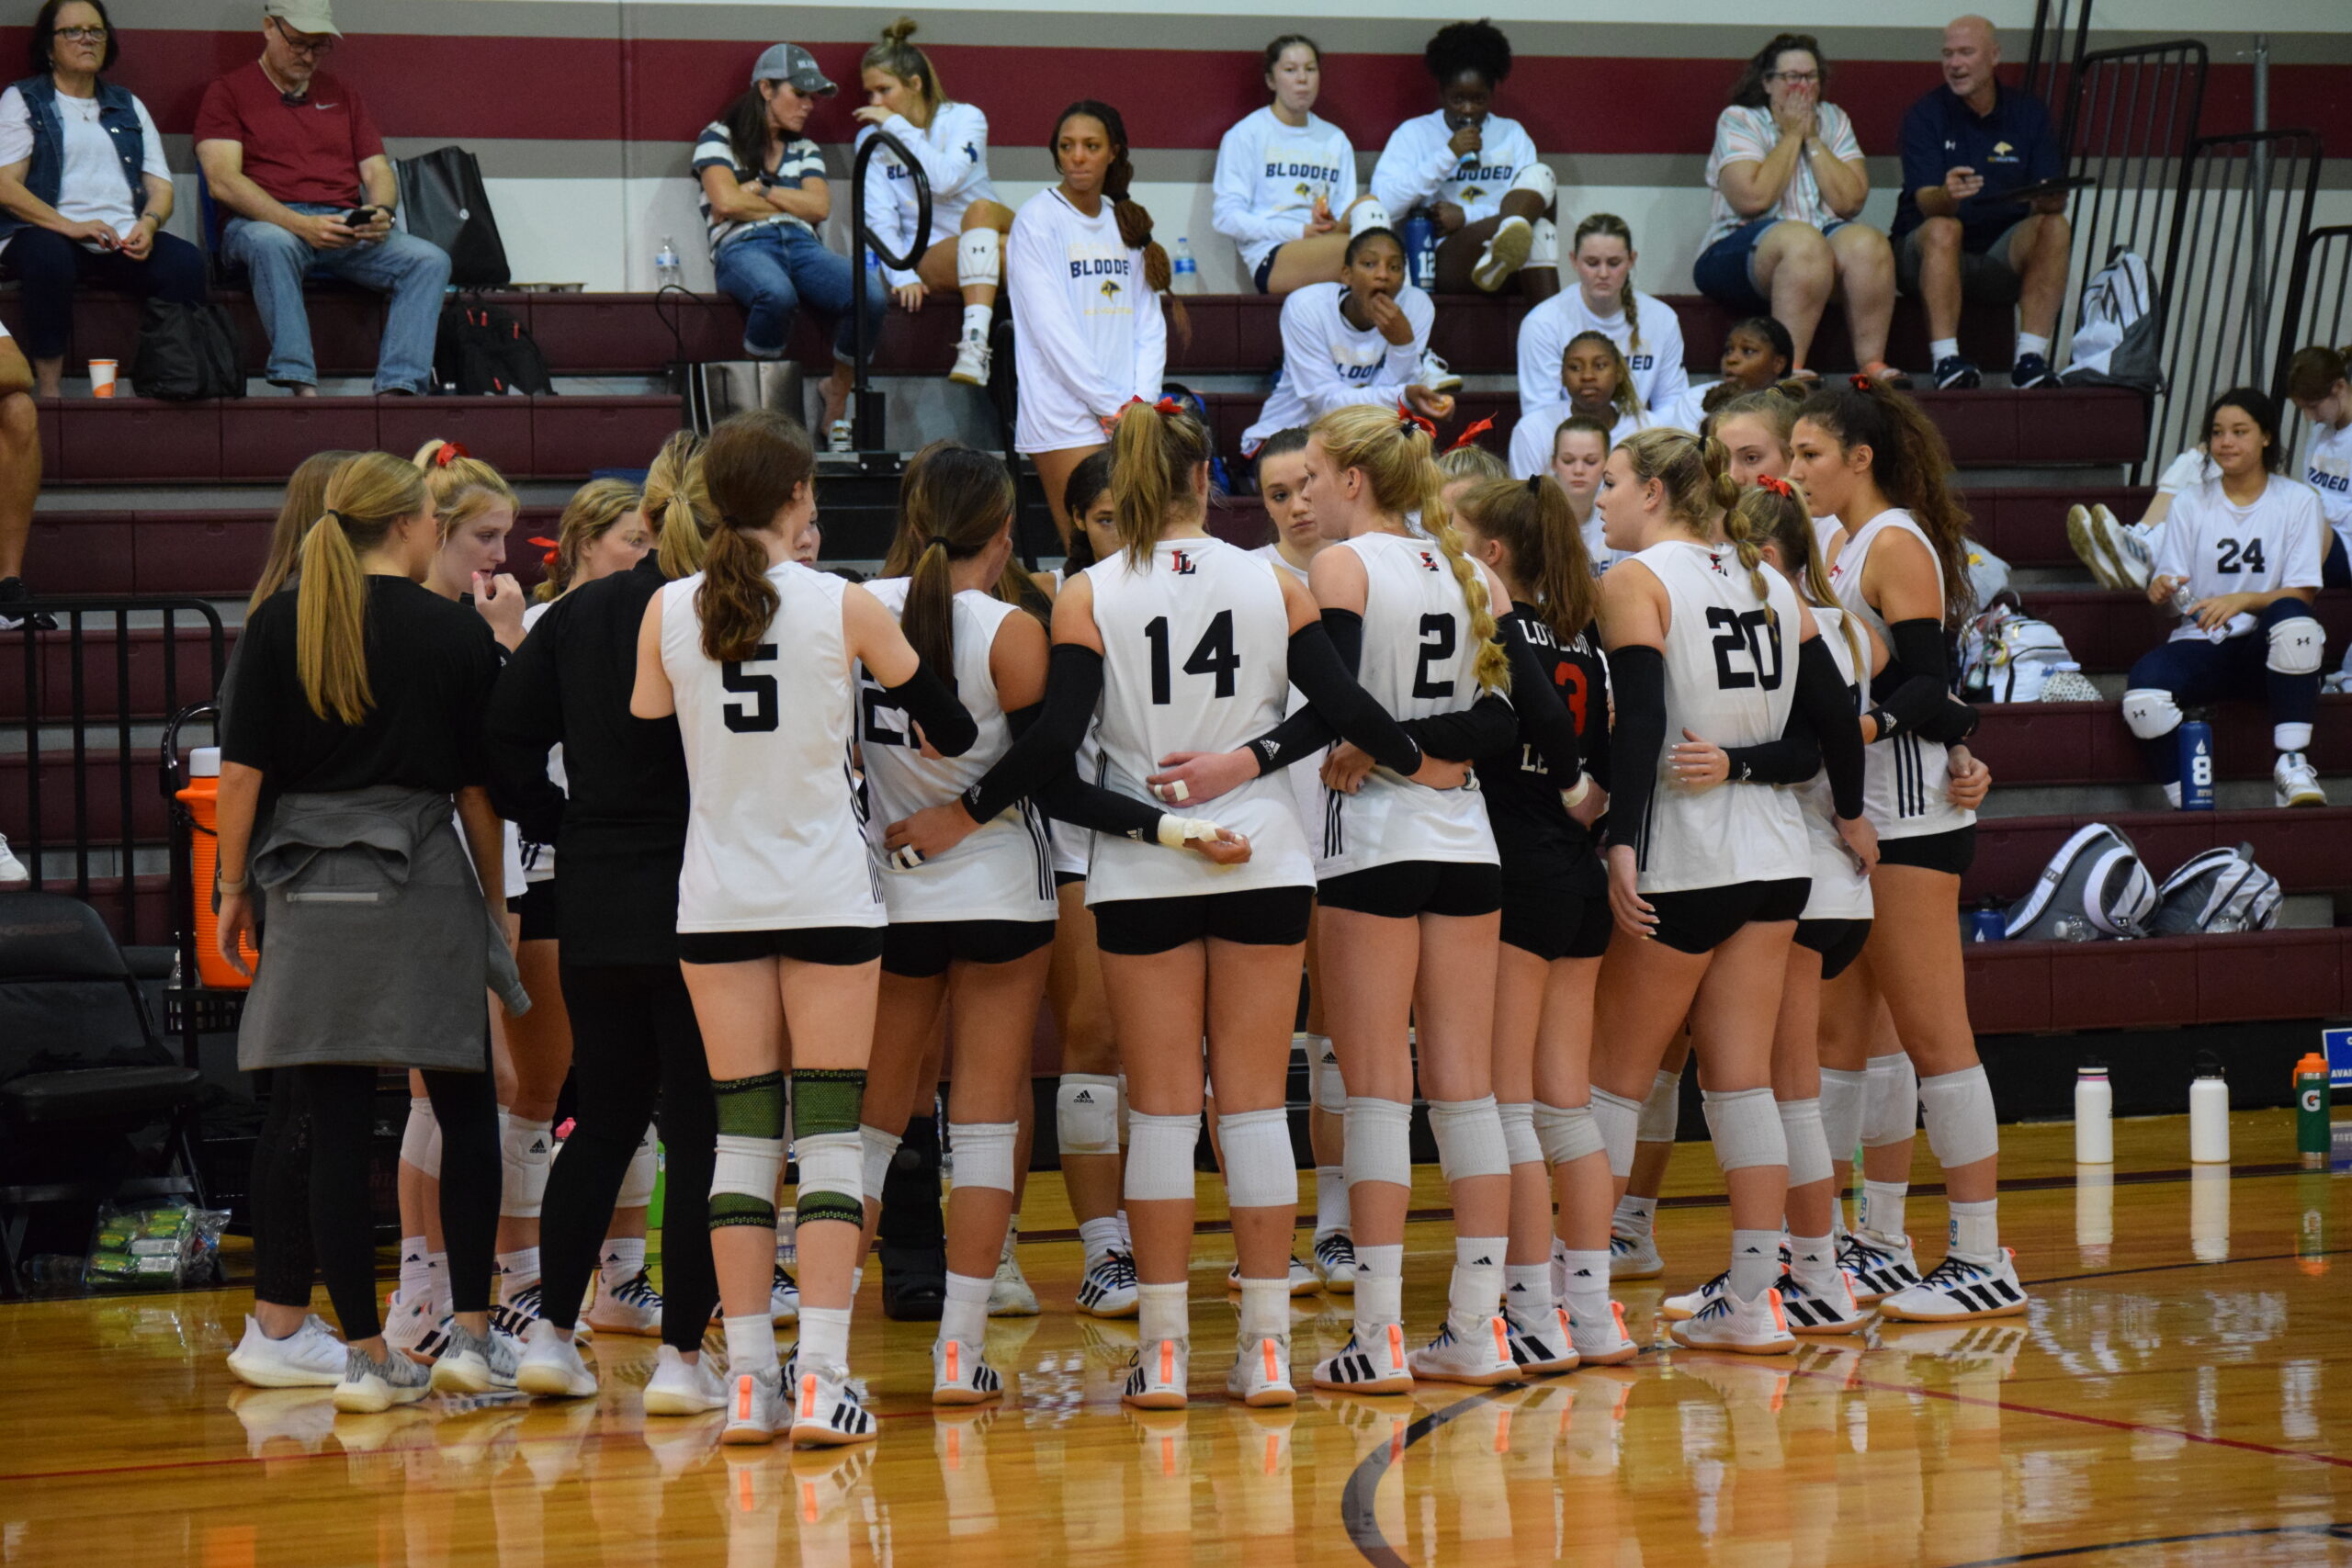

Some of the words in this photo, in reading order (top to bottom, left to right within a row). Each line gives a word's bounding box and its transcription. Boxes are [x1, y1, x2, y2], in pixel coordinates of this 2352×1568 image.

[1265, 163, 1340, 183] BLOODED
[1419, 251, 1436, 279] 12
[2217, 537, 2265, 574] 24
[1145, 609, 1240, 705] 14
[1412, 613, 1456, 699] 2
[1705, 606, 1782, 691] 20
[722, 643, 779, 733] 5
[1555, 661, 1588, 737] 3
[2192, 755, 2212, 786] 8
[2301, 1089, 2321, 1112] G
